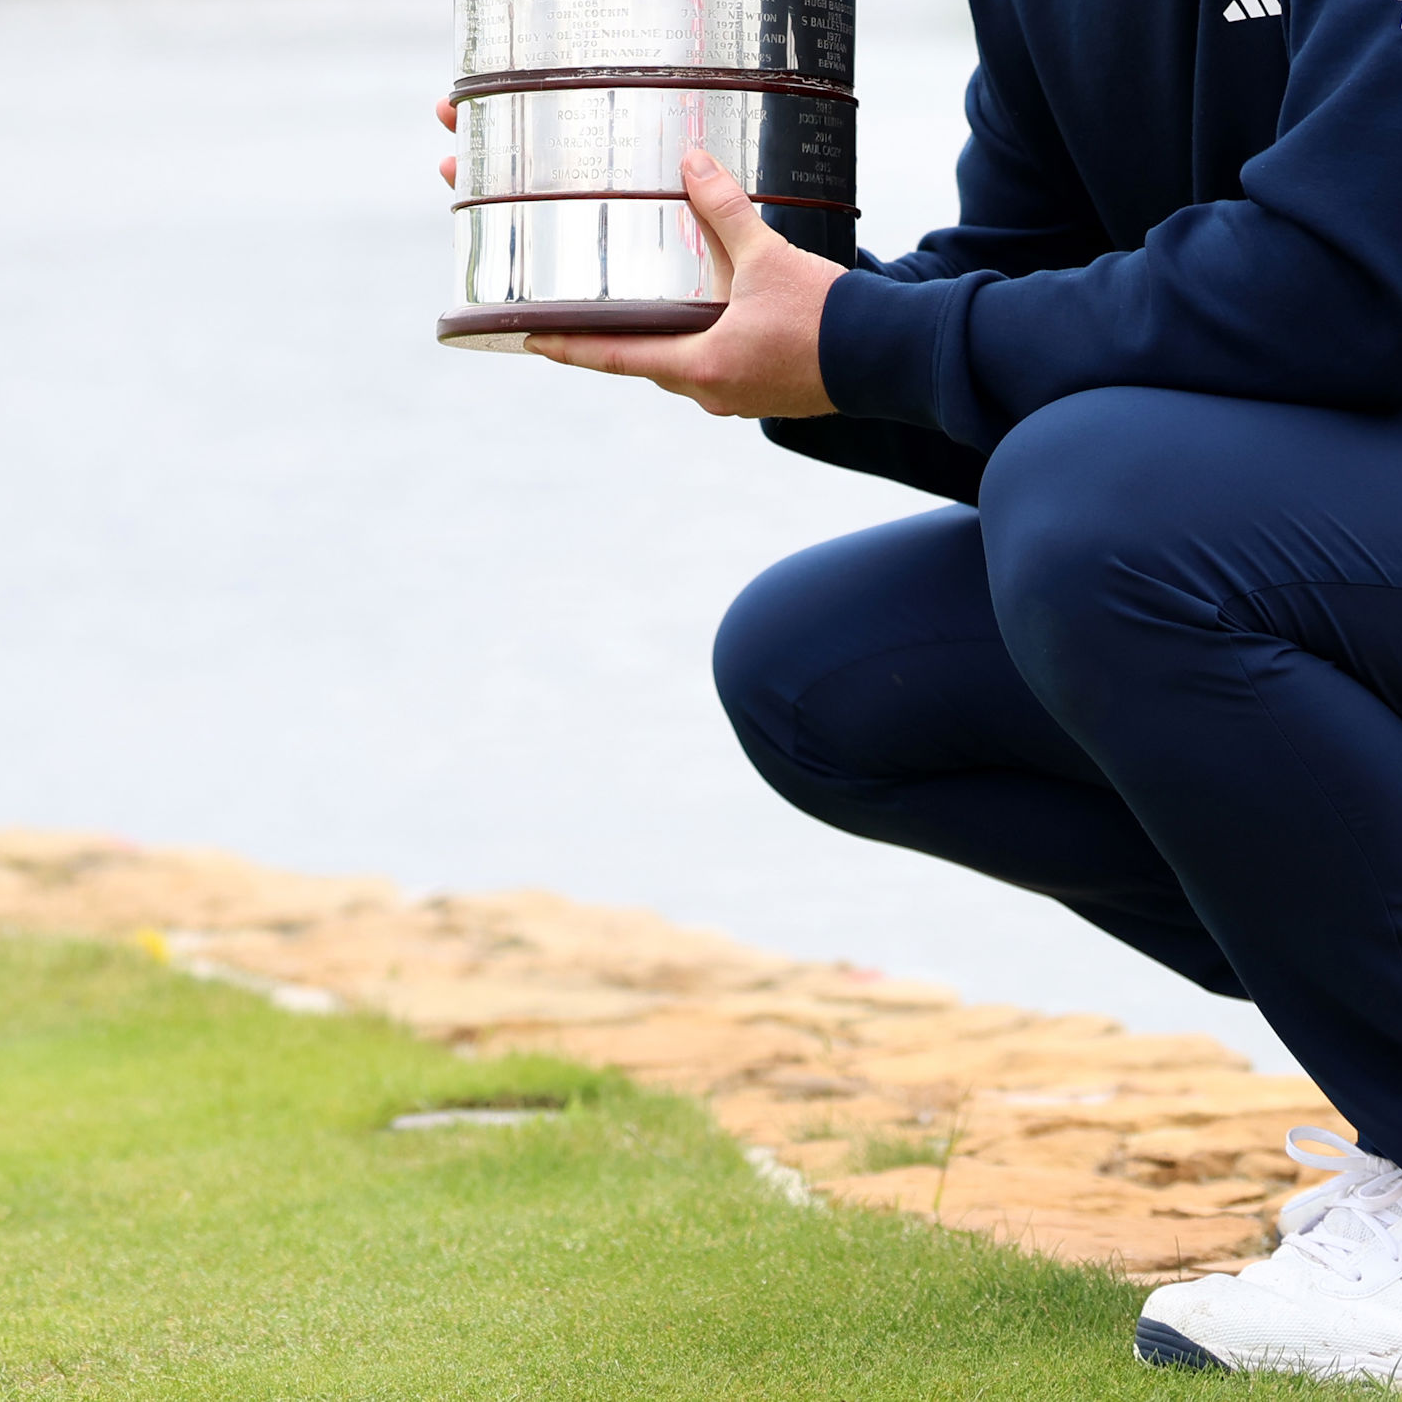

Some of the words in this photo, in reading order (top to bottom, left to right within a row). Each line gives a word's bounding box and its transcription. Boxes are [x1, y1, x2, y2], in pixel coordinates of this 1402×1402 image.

[546, 9, 579, 20] JOHN
[728, 10, 777, 23] NEWTON
[517, 32, 541, 44] GUY
[583, 48, 663, 59] FERNANDEZ
[686, 49, 723, 59] BRIAN
[721, 107, 768, 121] KAYMER
[548, 137, 592, 149] DARREN
[594, 136, 641, 148] CLARKE
[551, 169, 589, 180] SIMON
[592, 168, 634, 179] DYSON
